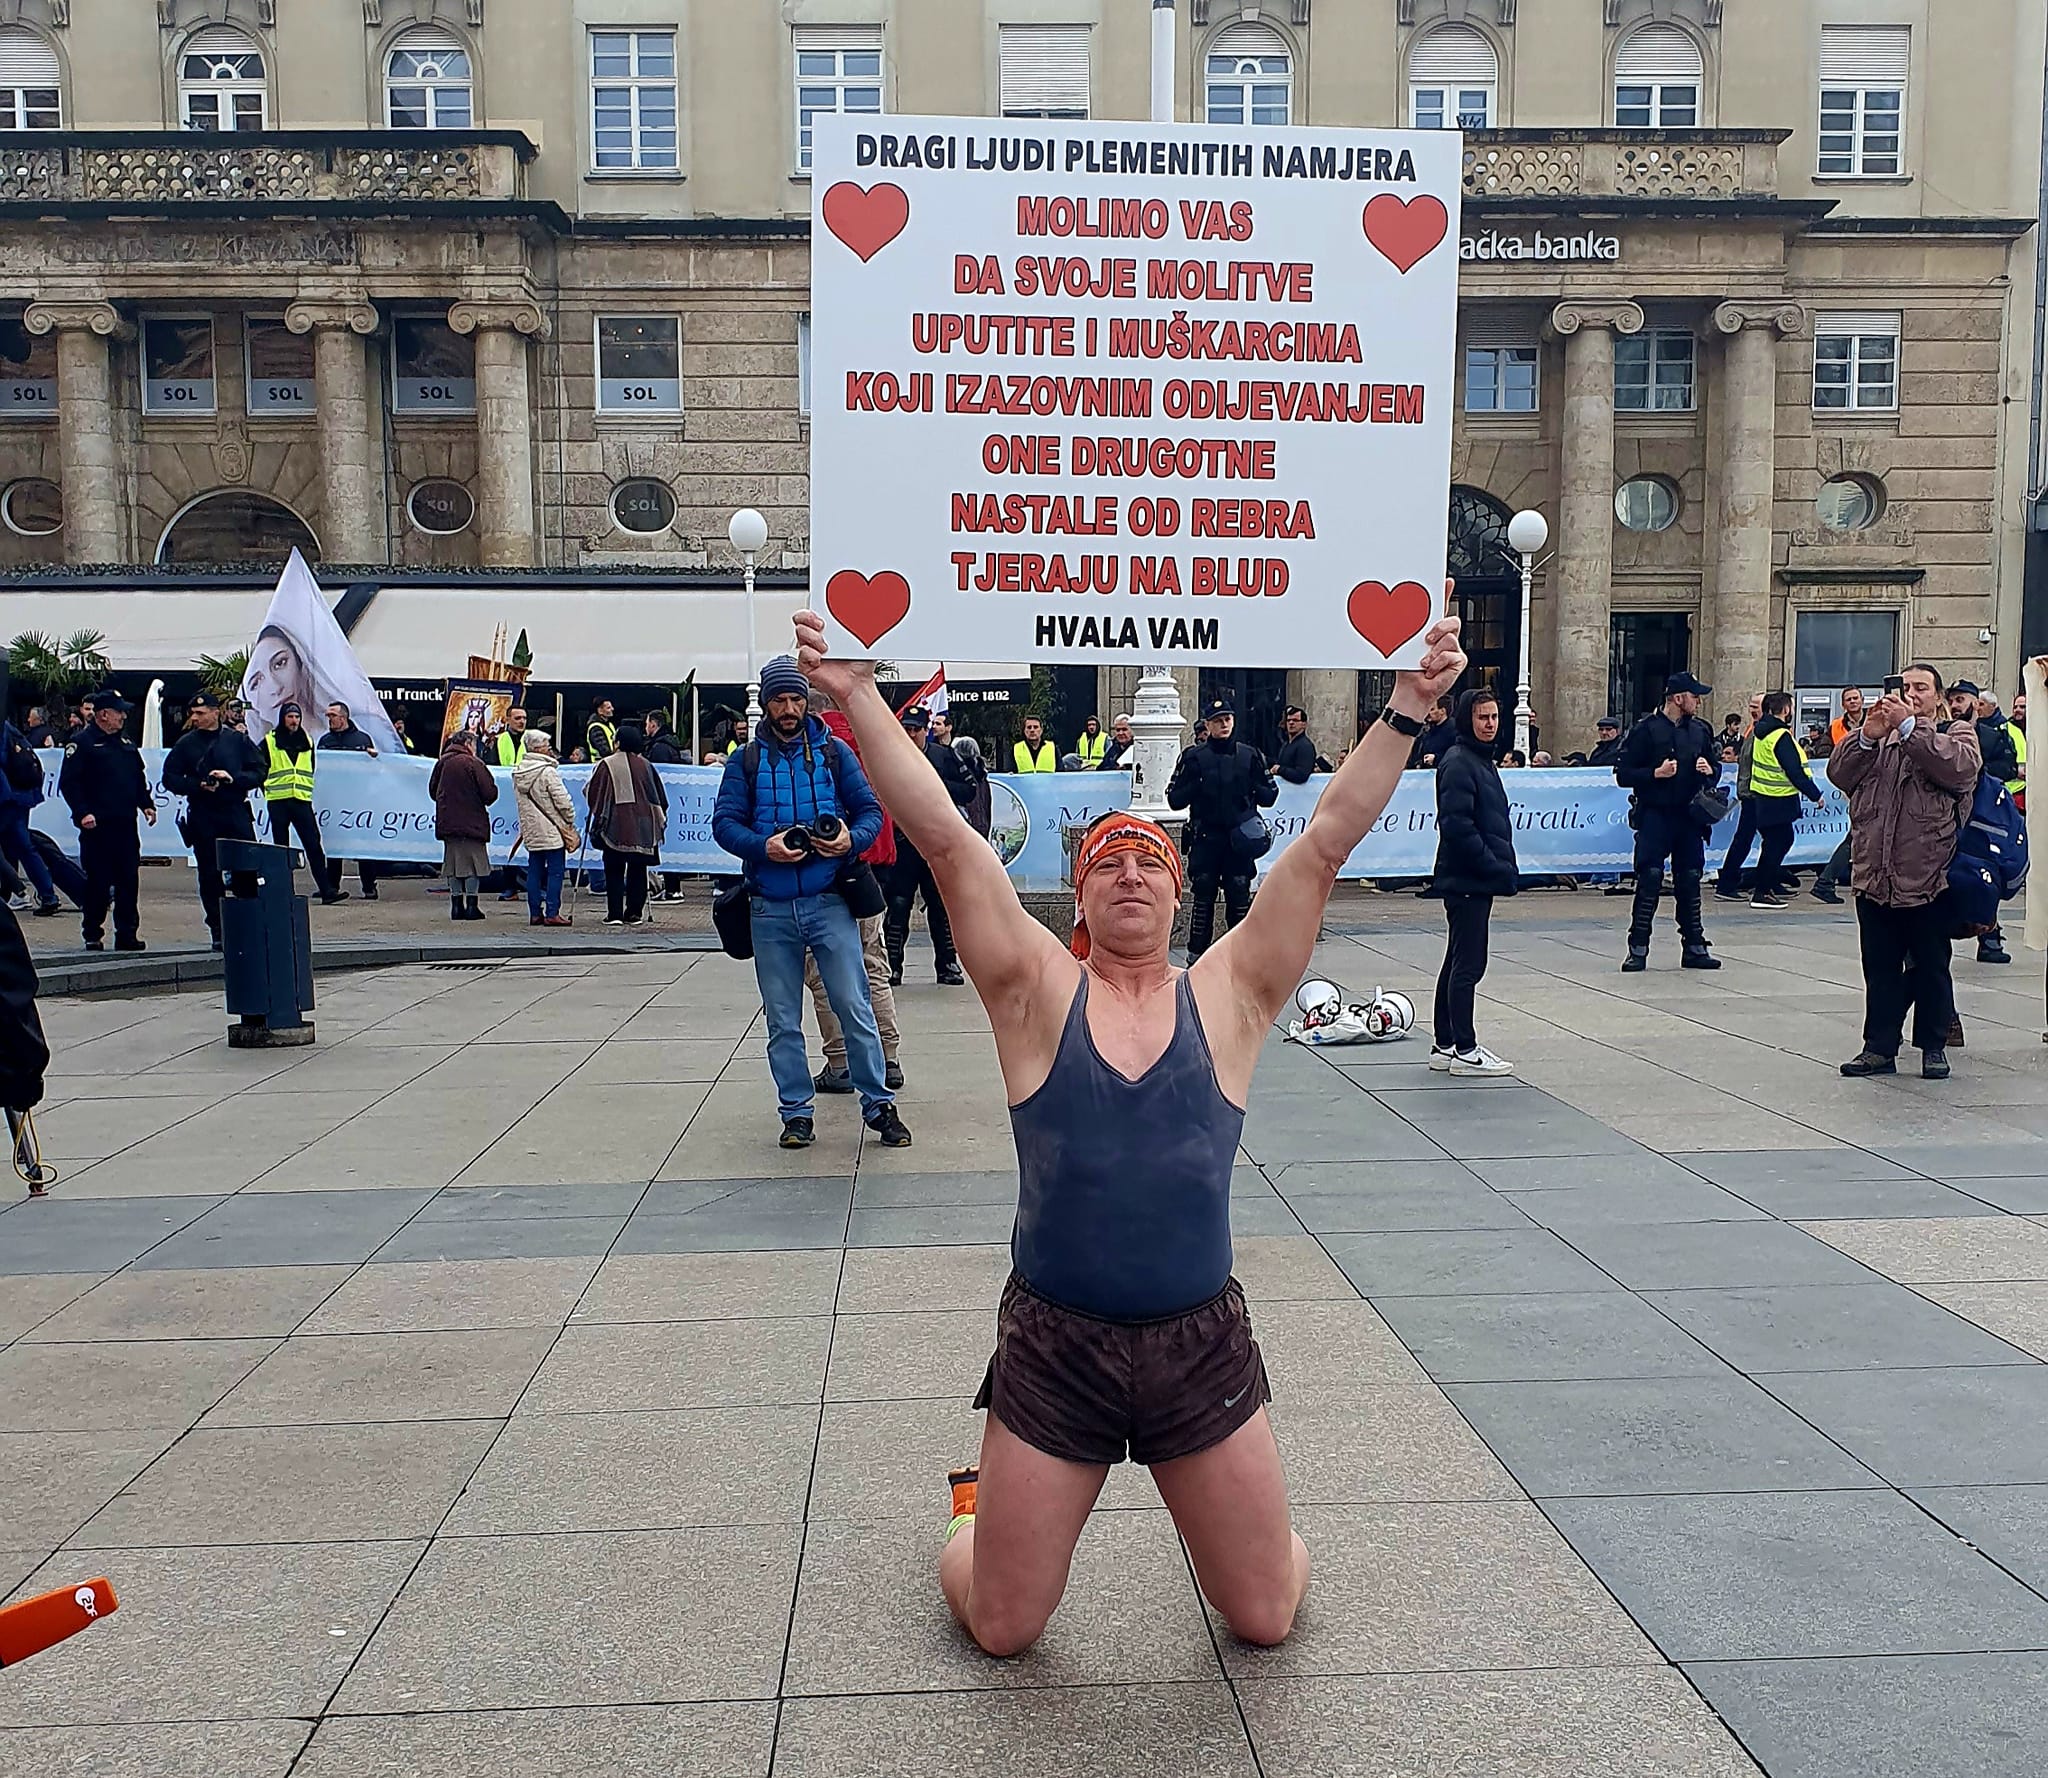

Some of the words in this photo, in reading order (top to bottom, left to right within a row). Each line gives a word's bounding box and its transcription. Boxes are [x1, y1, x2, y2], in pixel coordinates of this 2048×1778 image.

[857, 135, 955, 169] DRAGI
[967, 137, 1054, 171] LJUDI
[1066, 140, 1252, 177] PLEMENITIH
[1263, 146, 1416, 181] NAMJERA
[1018, 196, 1169, 239] MOLIMO
[1180, 200, 1253, 241] VAS
[1460, 229, 1523, 260] ačka
[1534, 230, 1620, 260] banka
[955, 255, 1005, 295] DA
[1014, 256, 1136, 298] SVOJE
[1148, 259, 1313, 302] MOLITVE
[913, 313, 1074, 356] UPUTITE
[1086, 318, 1097, 357] I
[1109, 311, 1363, 363] MUŠKARCIMA
[13, 387, 48, 401] SOL
[163, 387, 198, 401] SOL
[268, 387, 303, 401] SOL
[419, 386, 455, 400] SOL
[623, 386, 657, 401] SOL
[846, 371, 933, 413] KOJI
[946, 374, 1152, 417] IZAZOVNIM
[1163, 379, 1424, 424] ODIJEVANJEM
[983, 434, 1060, 475] ONE
[1072, 437, 1275, 479] DRUGOTNE
[629, 499, 660, 512] SOL
[952, 493, 1118, 535] NASTALE
[1128, 497, 1180, 537] OD
[1191, 499, 1315, 540] REBRA
[951, 552, 1118, 594] TJERAJU
[1130, 556, 1182, 595] NA
[1192, 557, 1289, 598] BLUD
[1036, 616, 1139, 648] HVALA
[1148, 618, 1219, 650] VAM
[396, 687, 445, 701] Franck
[338, 809, 373, 829] za
